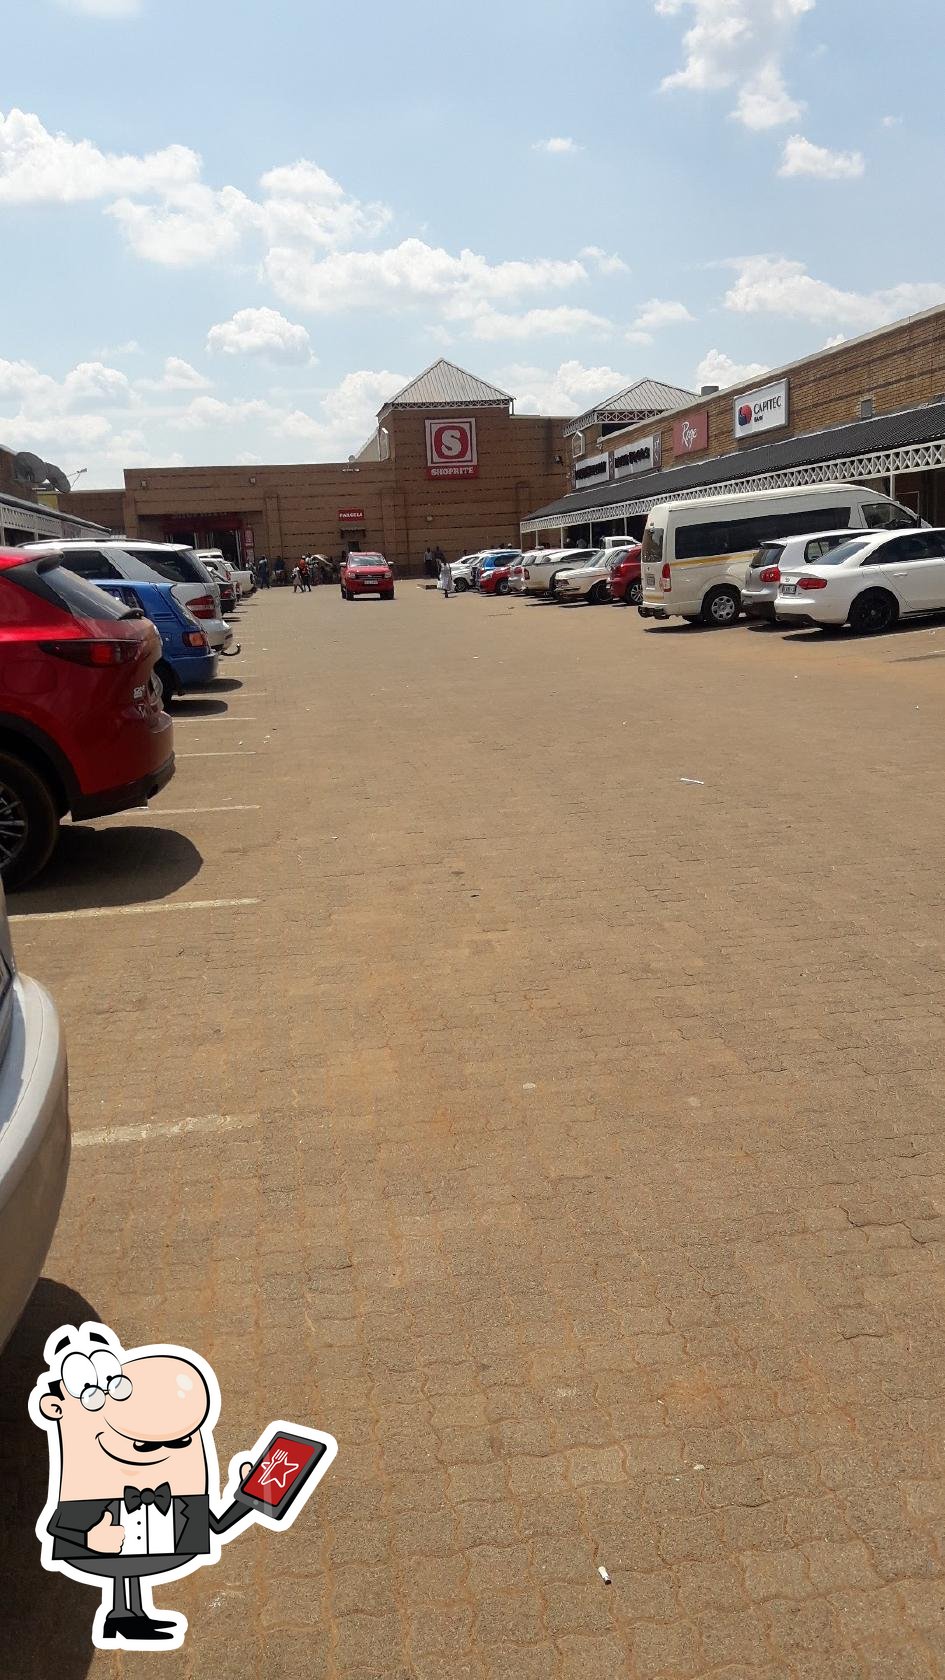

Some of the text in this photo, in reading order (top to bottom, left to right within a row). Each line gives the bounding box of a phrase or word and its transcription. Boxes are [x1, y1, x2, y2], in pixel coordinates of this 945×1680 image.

[753, 395, 782, 415] CAPITEC
[441, 429, 462, 457] S
[431, 467, 474, 476] SHOPRITE
